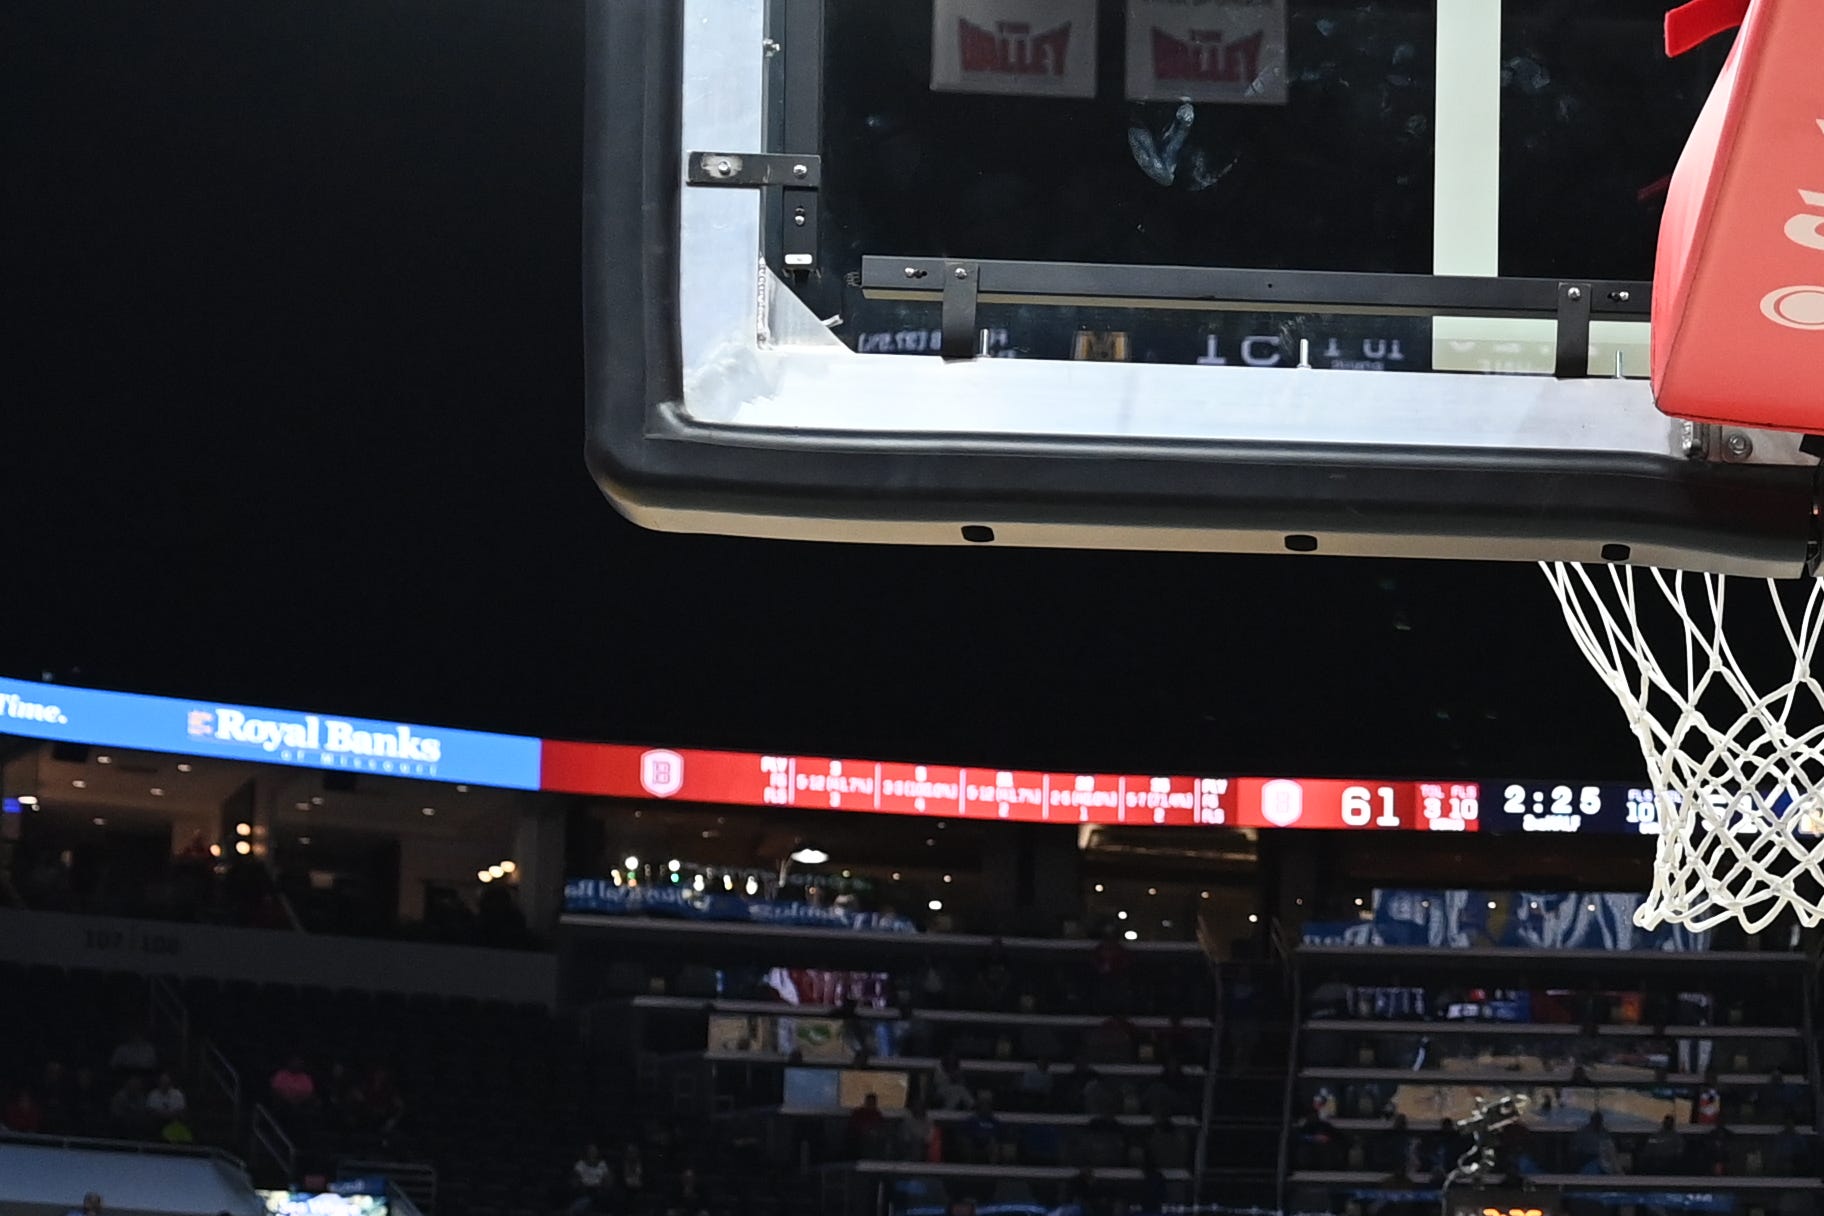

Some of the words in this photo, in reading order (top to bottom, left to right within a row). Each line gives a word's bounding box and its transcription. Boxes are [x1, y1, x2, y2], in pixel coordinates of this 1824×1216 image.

[215, 708, 320, 752] Royal
[323, 719, 442, 763] Banks
[1340, 786, 1400, 827] 61
[1449, 798, 1479, 821] 10
[1503, 784, 1602, 815] 2:25
